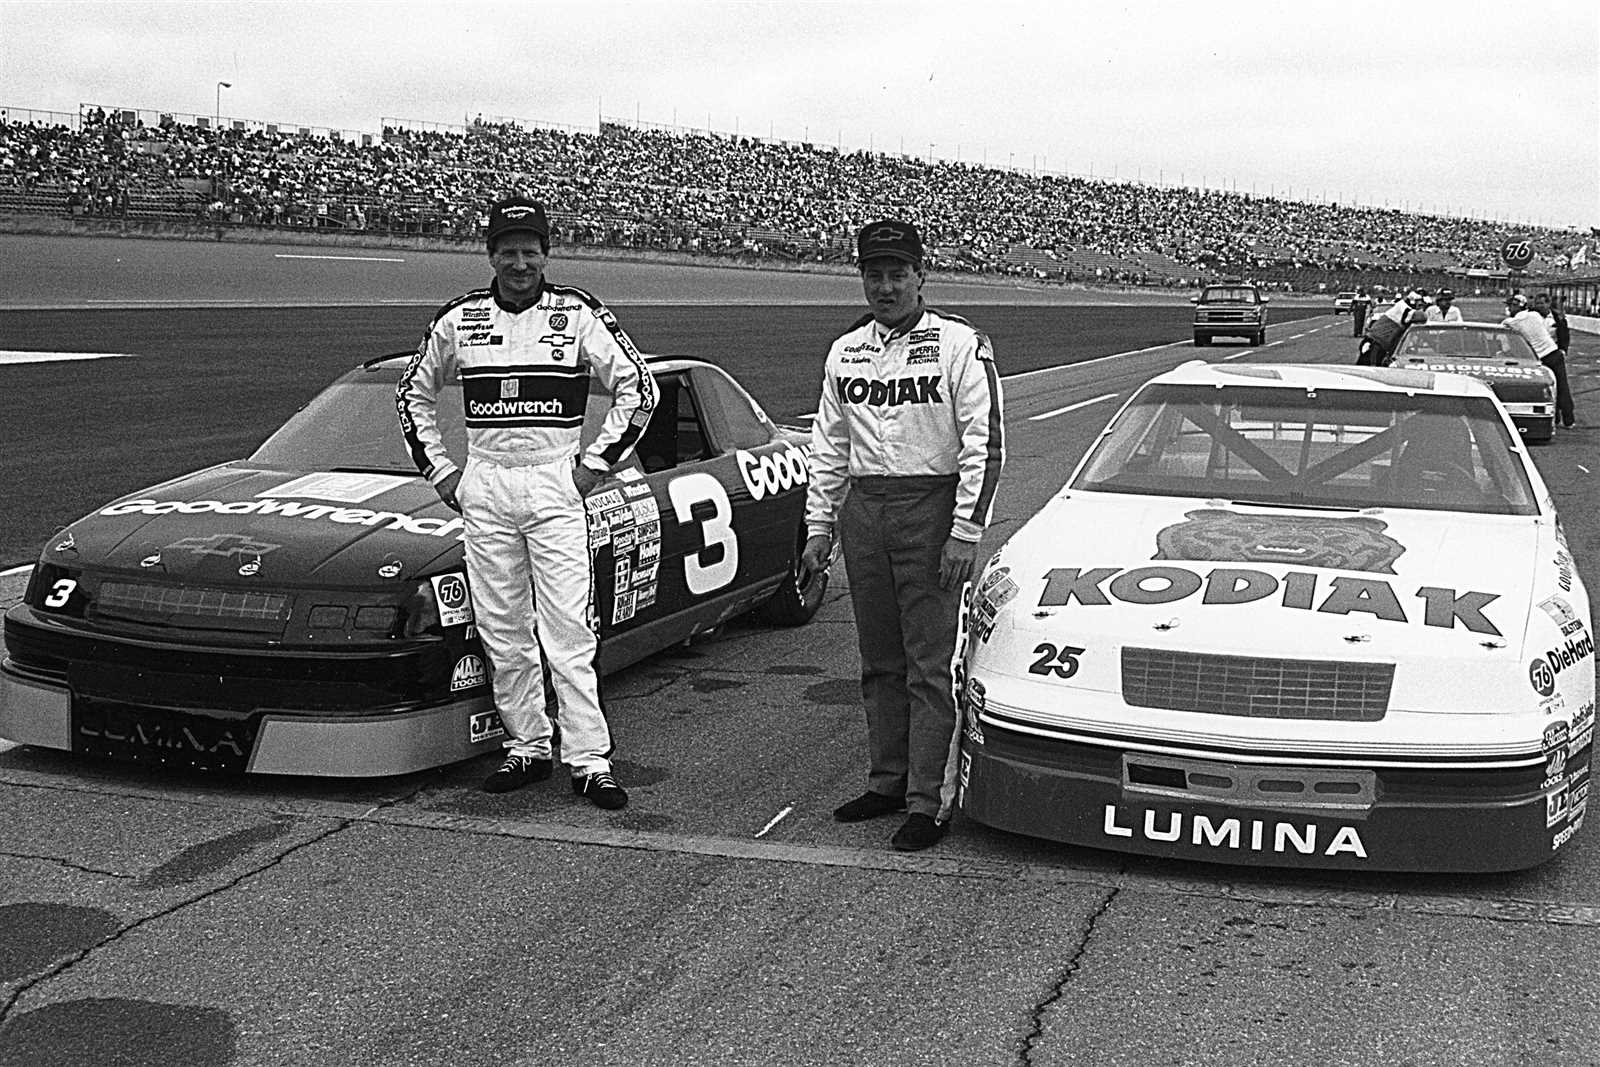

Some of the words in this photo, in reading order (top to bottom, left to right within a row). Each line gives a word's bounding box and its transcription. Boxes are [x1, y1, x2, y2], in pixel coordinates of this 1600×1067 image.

[1506, 241, 1531, 259] 76
[551, 315, 567, 328] 76
[836, 375, 944, 407] KODIAK
[469, 398, 563, 416] Goodwrench
[100, 499, 466, 541] Goodwrench
[667, 472, 739, 595] 3
[45, 578, 77, 608] 3
[442, 580, 463, 604] 76
[1038, 566, 1504, 637] KODIAK
[1028, 642, 1086, 679] 25
[1545, 629, 1595, 675] DieHard
[453, 657, 484, 681] MAC
[453, 675, 485, 689] TOOLS
[1532, 663, 1552, 692] 76
[1104, 804, 1368, 858] LUMINA
